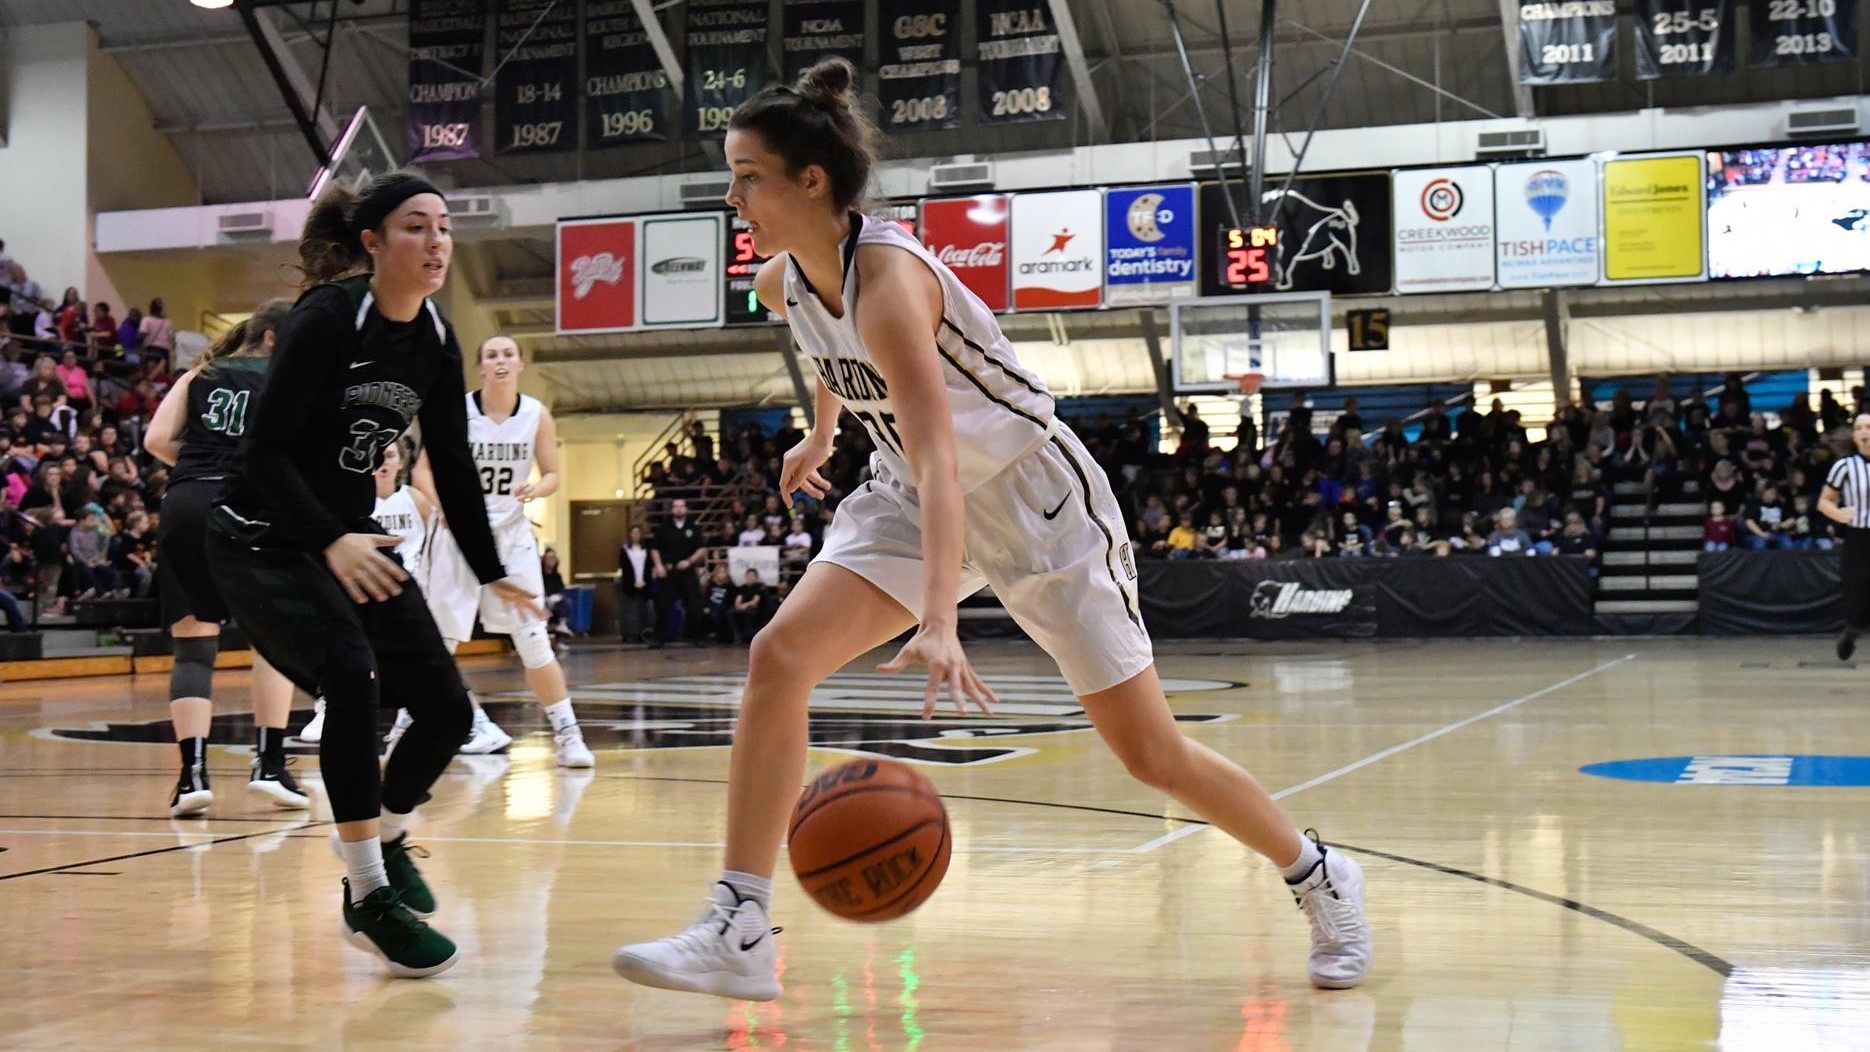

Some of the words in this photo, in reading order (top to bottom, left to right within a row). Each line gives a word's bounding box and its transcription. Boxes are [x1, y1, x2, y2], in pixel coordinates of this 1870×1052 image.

[1520, 1, 1616, 20] CHAMPIONS
[1654, 9, 1719, 35] 25-5
[1769, 0, 1836, 20] 22-10
[801, 19, 844, 34] NCAA
[990, 9, 1047, 36] NCAA
[1542, 43, 1594, 64] 2011
[1660, 42, 1713, 64] 2011
[1775, 31, 1832, 55] 2013
[410, 82, 478, 102] CHAMPION
[703, 69, 746, 91] 24-6
[517, 82, 561, 104] 18-14
[992, 86, 1050, 116] 2008
[698, 107, 736, 131] 199
[891, 95, 947, 124] 2008
[512, 121, 562, 147] 1987
[601, 109, 654, 137] 1996
[423, 123, 469, 148] 1987
[1400, 225, 1490, 241] CREEKWOOD
[1019, 257, 1093, 275] aramark
[1108, 258, 1192, 277] dentistry
[1227, 250, 1271, 284] 25
[1349, 314, 1389, 349] 15
[201, 388, 250, 437] 31
[480, 467, 513, 495] 32
[863, 847, 924, 898] ROCK
